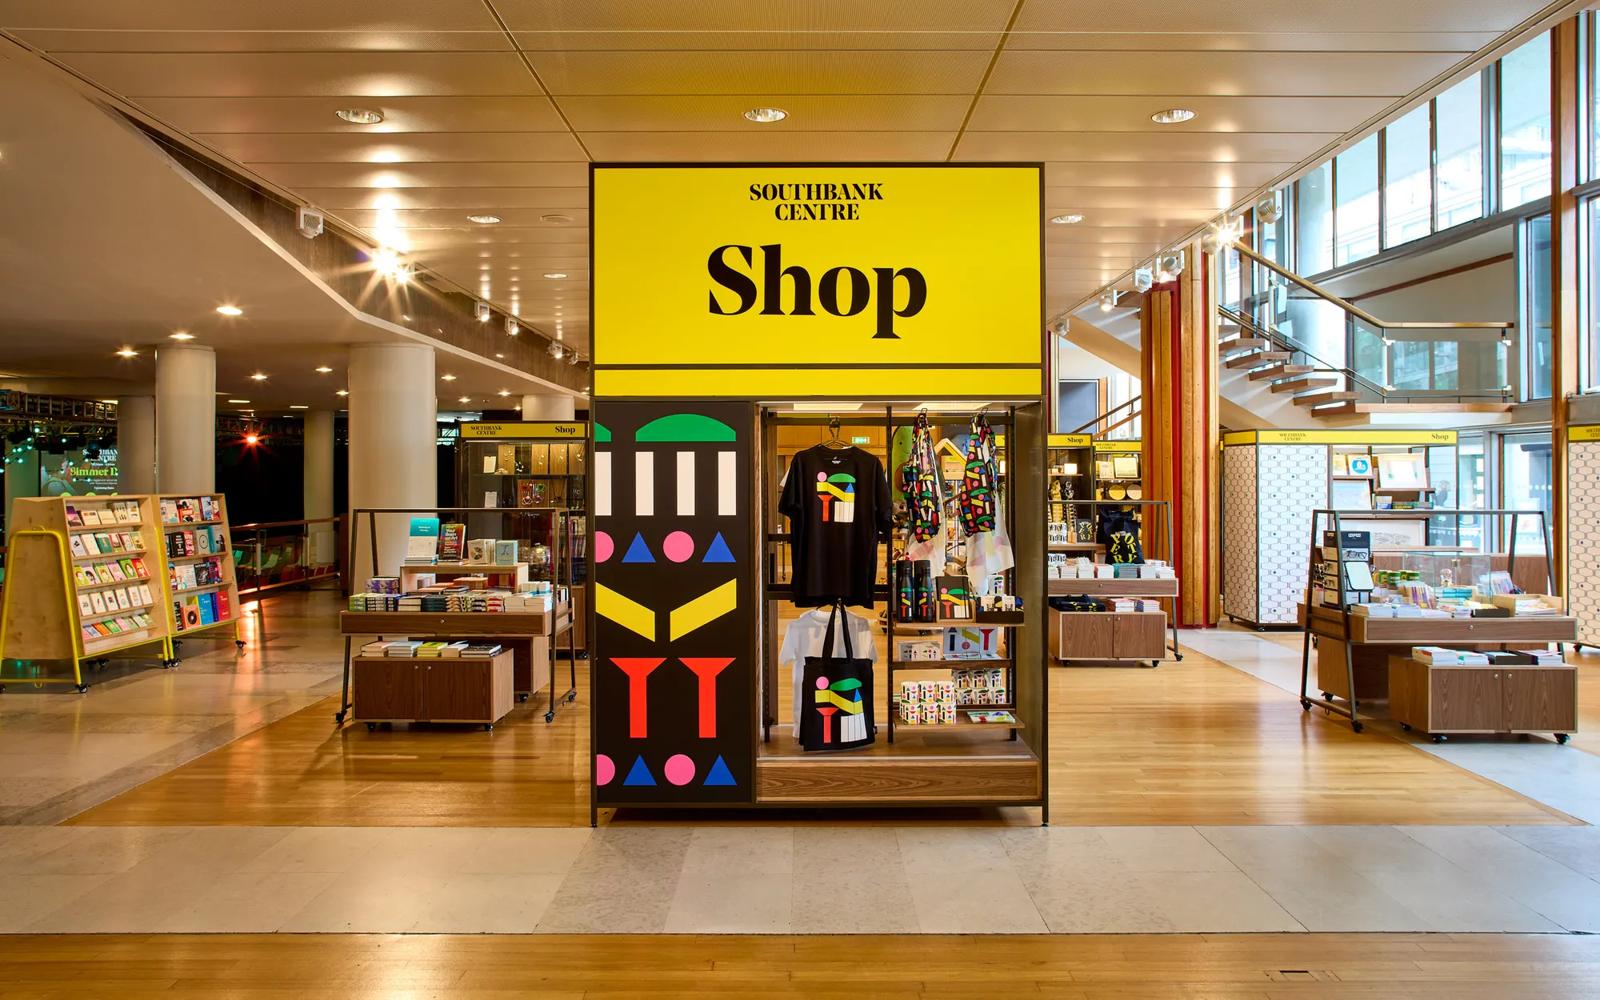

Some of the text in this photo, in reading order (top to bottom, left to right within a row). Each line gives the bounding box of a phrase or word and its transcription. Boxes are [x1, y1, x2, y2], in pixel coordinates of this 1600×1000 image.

[750, 183, 883, 200] SOUTHBANK
[774, 203, 860, 221] CENTRE
[707, 243, 927, 340] Shop
[554, 425, 576, 435] Shop
[1431, 432, 1449, 441] Shop
